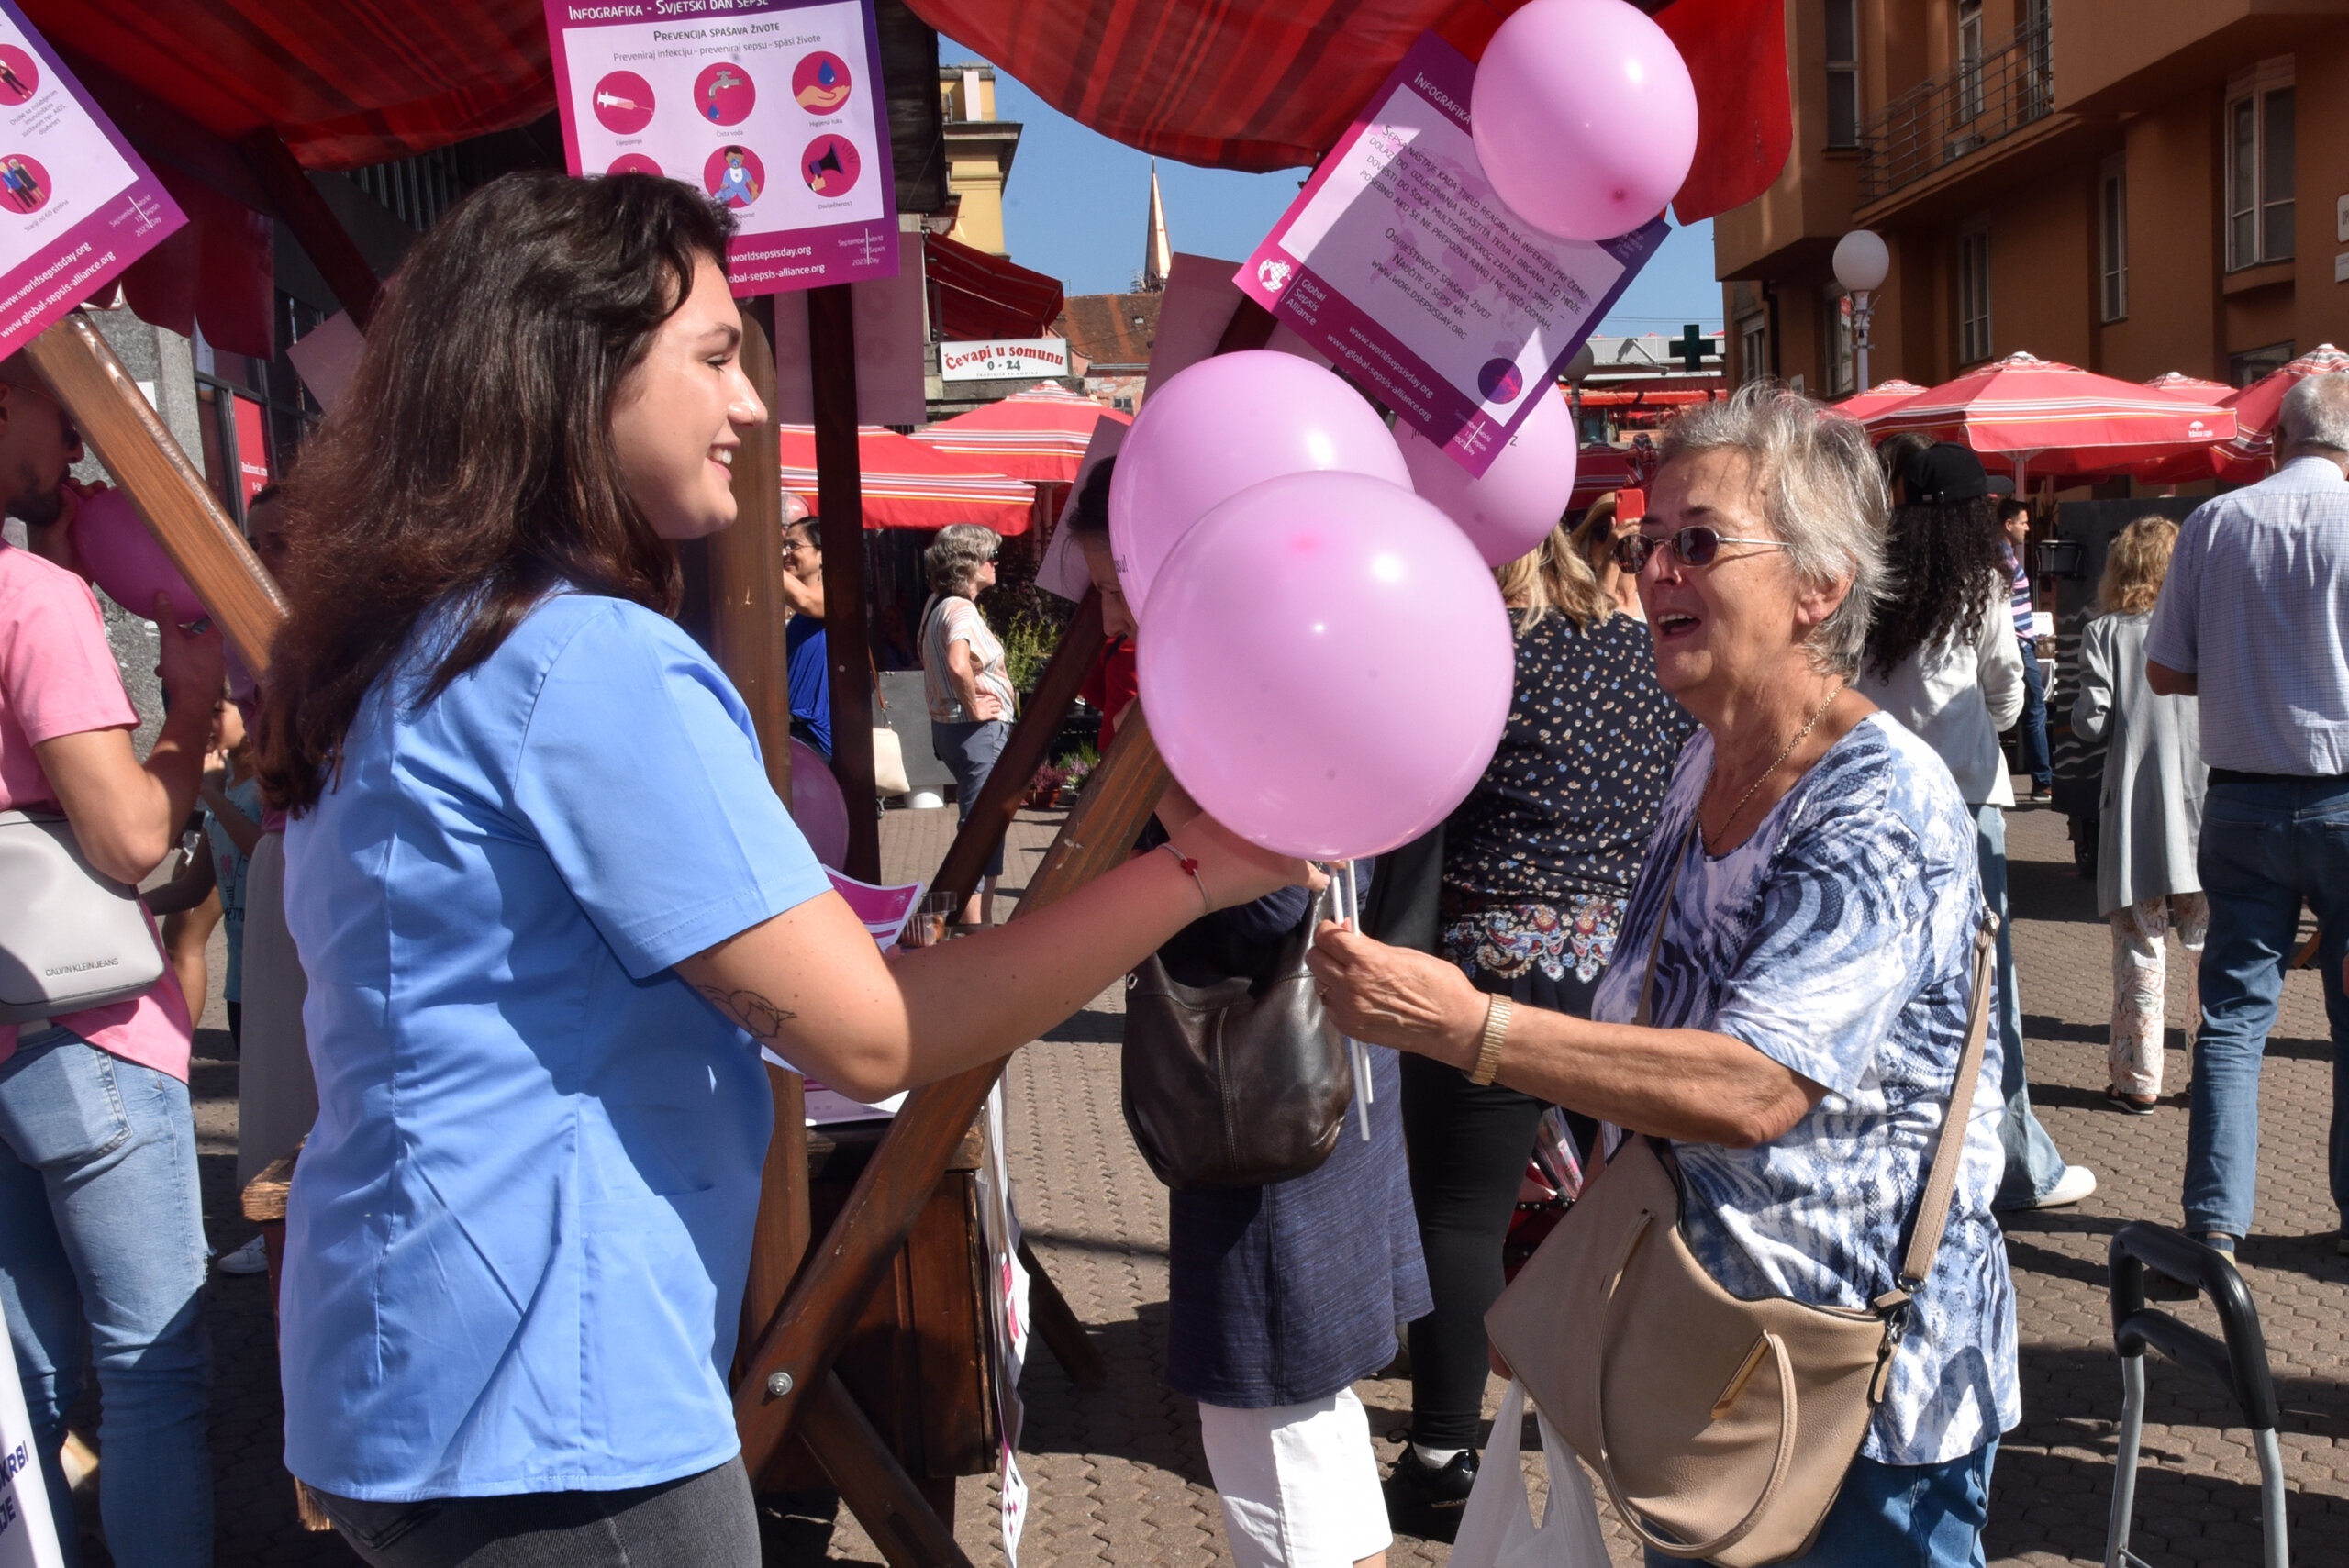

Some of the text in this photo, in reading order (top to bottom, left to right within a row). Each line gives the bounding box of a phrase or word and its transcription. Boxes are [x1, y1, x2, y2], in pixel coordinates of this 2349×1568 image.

[568, 5, 643, 21] INFOGRAFIKA
[653, 21, 780, 43] PREVENCIJA SPAŠAVA ŽIVOTE
[613, 49, 655, 63] Preveniraj
[657, 46, 693, 60] infekciju
[699, 42, 741, 56] preveniraj
[742, 40, 767, 51] sepsu
[774, 37, 794, 49] spasi
[796, 33, 821, 44] živote
[1396, 158, 1408, 170] DO
[1457, 208, 1491, 238] VLASTITA
[1491, 237, 1512, 255] TKIVA
[1516, 257, 1548, 286] ORGANA.
[1560, 294, 1582, 314] MOŽE
[1397, 179, 1408, 191] DO
[1431, 207, 1493, 261] MULTIORGANSKOG
[1491, 259, 1528, 291] ZATAJENJA
[1531, 292, 1553, 312] SMRTI
[1406, 146, 1437, 174] NASTAJE
[1437, 171, 1457, 190] KADA
[1458, 189, 1480, 209] TIJELO
[1479, 206, 1510, 234] REAGIRA
[1509, 232, 1521, 243] NA
[1520, 242, 1554, 272] INFEKCIJU
[1553, 269, 1567, 282] PRI
[1566, 279, 1588, 299] ČEMU
[0, 242, 92, 313] www.worldsepsisday.org
[728, 263, 826, 284] obal-sepsis-alliance.org
[1383, 227, 1492, 320] OSVIJEŠTENOST SPAŠAVA ŽIVOT
[1392, 253, 1426, 284] NAUČITE
[1422, 280, 1432, 291] O
[1431, 287, 1452, 306] SEPSI
[1393, 196, 1409, 212] AKO
[1408, 208, 1420, 220] SE
[1419, 217, 1431, 229] NE
[1431, 227, 1469, 261] PREPOZNA
[1468, 258, 1489, 278] RANO
[1493, 279, 1505, 291] NE
[1523, 305, 1553, 330] ODMAH.
[1, 251, 116, 338] www.global-sepsis-alliance.org
[1286, 297, 1317, 325] Alliance
[1292, 288, 1319, 313] Sepsis
[1300, 278, 1326, 301] Global
[1370, 259, 1467, 339] WWW.WORLDSEPSISDAY.ORG
[944, 345, 1063, 370] Čevapi u somunu
[987, 361, 995, 371] 0
[1006, 360, 1021, 371] 24
[1325, 332, 1433, 422] www.global-sepsis-alliance.org
[1346, 325, 1435, 399] www.worldsepsisday.org
[45, 958, 119, 977] CALVIN KLEIN JEANS
[0, 1440, 28, 1492] KRBI
